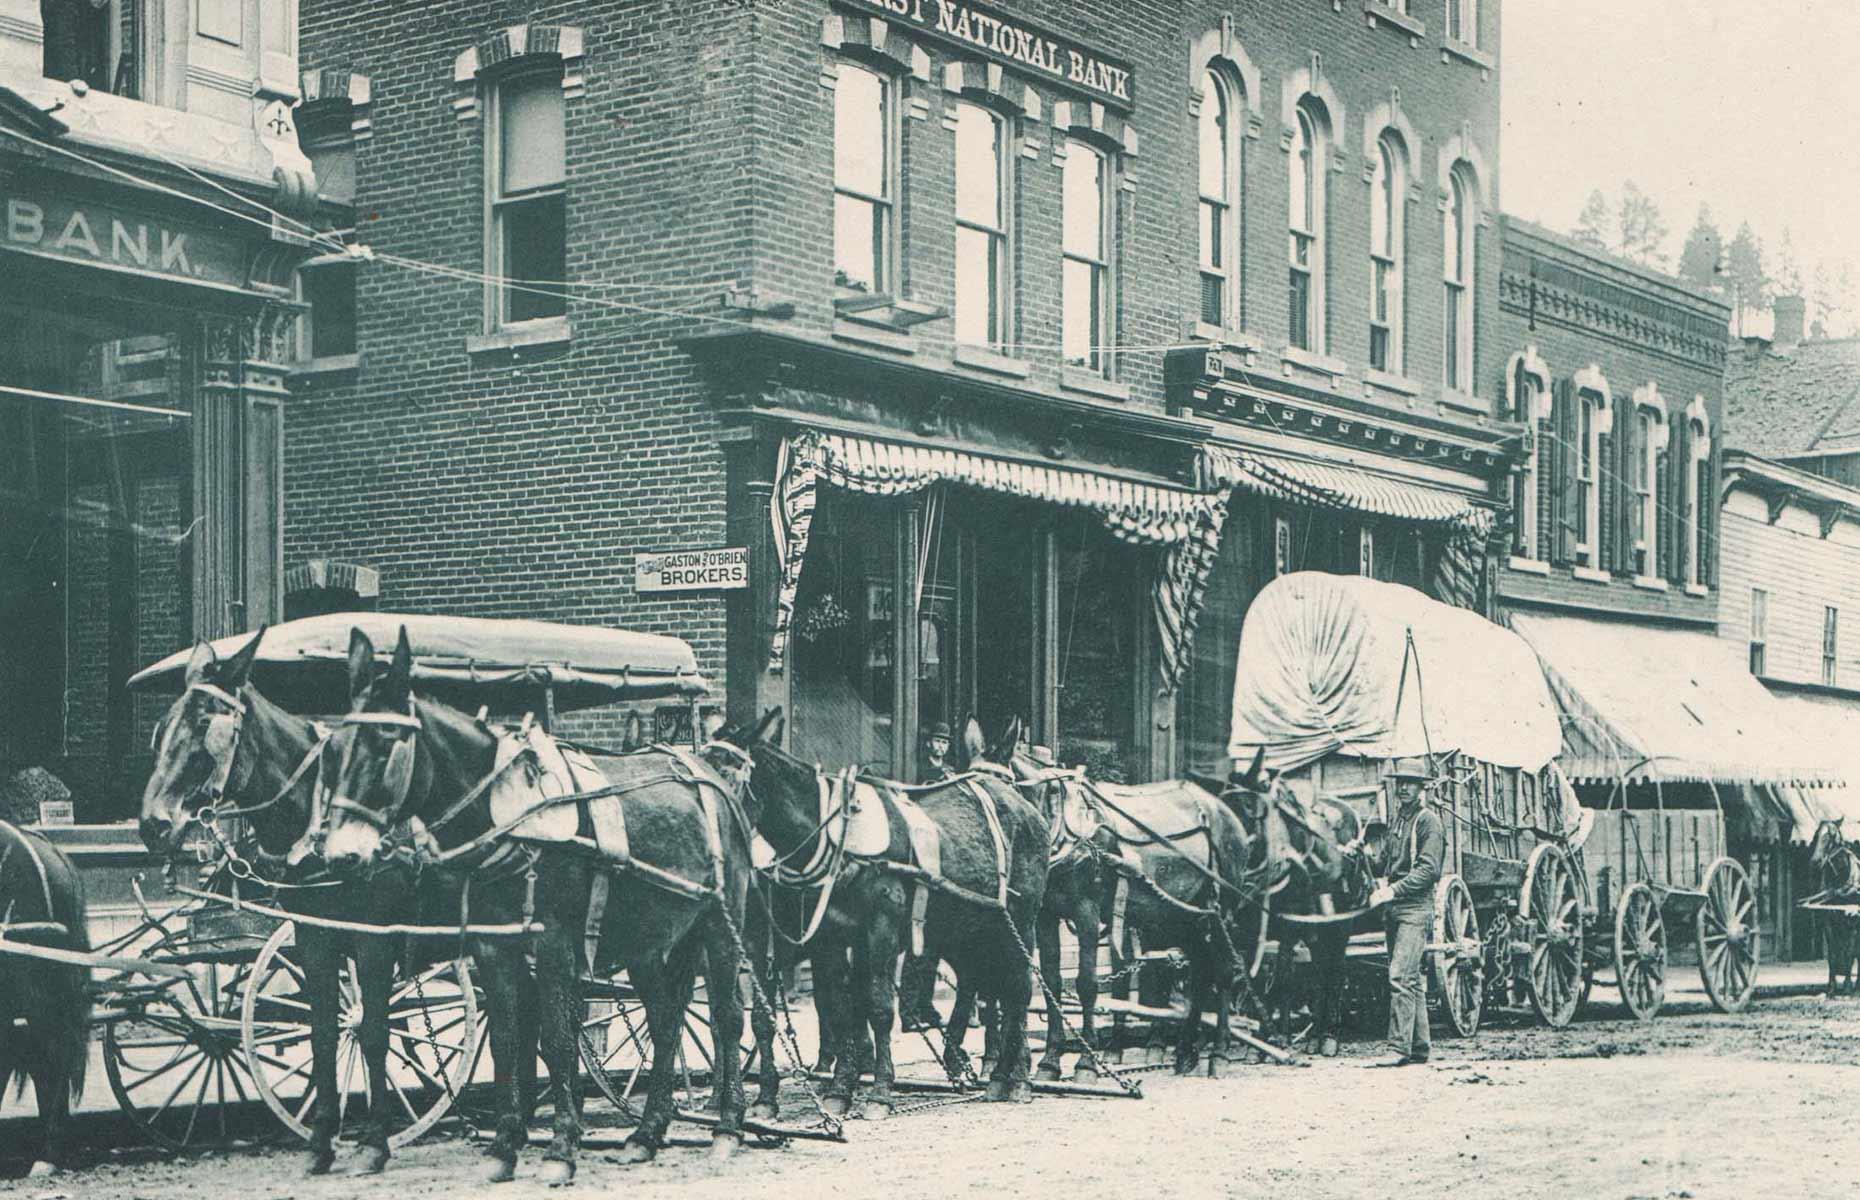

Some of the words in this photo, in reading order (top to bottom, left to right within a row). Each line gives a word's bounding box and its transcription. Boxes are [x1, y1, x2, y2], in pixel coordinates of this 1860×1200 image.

[935, 0, 1063, 76] NATIONAL
[1067, 50, 1131, 100] BANK
[664, 554, 701, 569] GASTON
